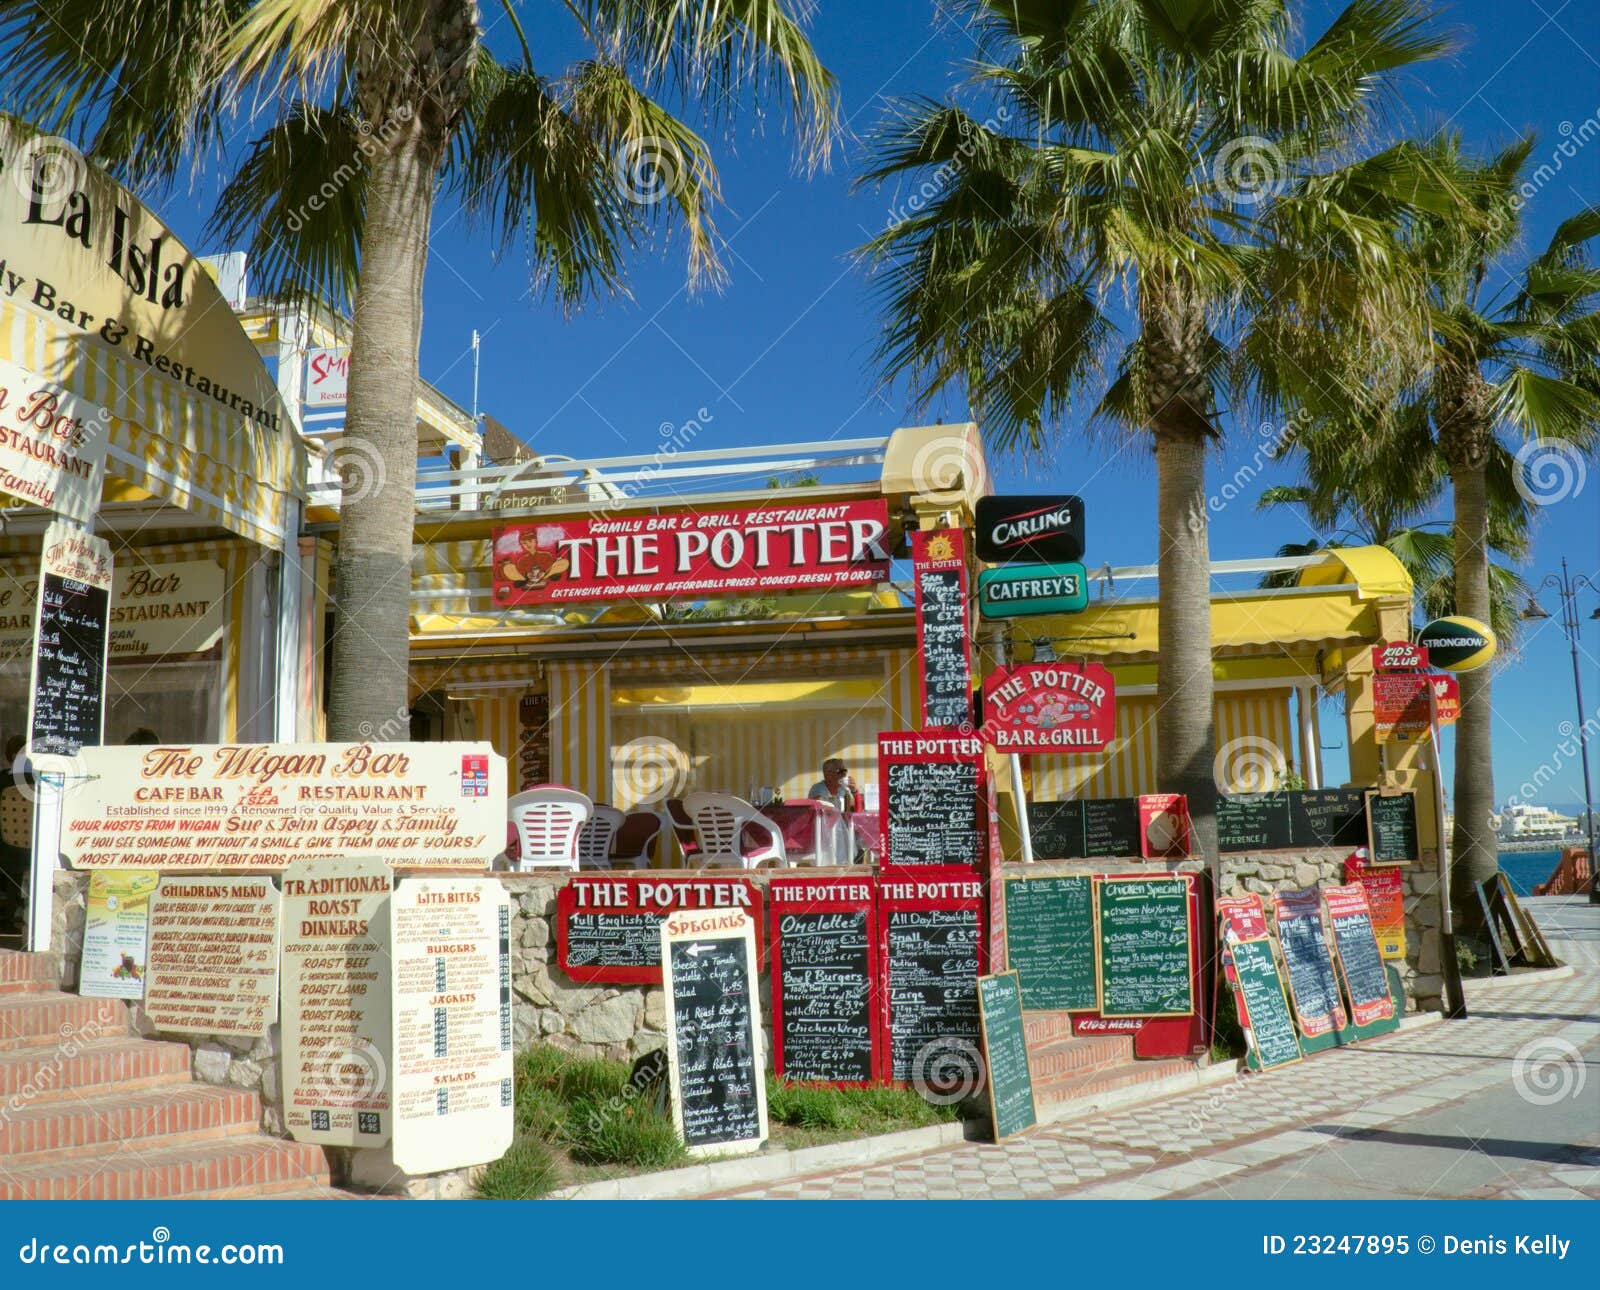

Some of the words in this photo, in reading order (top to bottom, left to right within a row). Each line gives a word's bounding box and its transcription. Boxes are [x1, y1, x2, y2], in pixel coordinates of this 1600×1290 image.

[22, 152, 92, 249] La
[106, 205, 184, 310] Isla
[31, 278, 94, 330] Bar
[100, 318, 128, 345] &
[133, 334, 281, 433] Restaurant
[17, 390, 86, 449] Bar
[0, 425, 93, 478] STAURANT
[590, 518, 643, 535] FAMILY
[646, 517, 676, 531] BAR
[680, 517, 692, 529] &
[697, 513, 741, 529] GRILL
[744, 505, 850, 524] RESTAURANT
[991, 509, 1072, 545] CARLING
[557, 532, 660, 579] THE
[675, 519, 889, 574] POTTER
[915, 562, 931, 570] THE
[932, 559, 962, 568] POTTER
[120, 570, 182, 600] Bar
[551, 588, 601, 598] EXTENSIVE
[603, 586, 625, 595] FOOD
[626, 583, 650, 593] MENU
[652, 582, 664, 591] AT
[665, 579, 724, 590] AFFORDABLE
[725, 577, 756, 587] PRICES
[759, 574, 797, 585] COOKED
[797, 572, 832, 583] FRESH
[835, 571, 848, 581] TO
[849, 569, 885, 581] ORDER
[989, 575, 1076, 601] CAFFREY'S
[110, 601, 209, 624] ESTAURANT
[1422, 637, 1482, 648] STRONGBOW
[1384, 656, 1418, 666] CLUB
[987, 676, 1027, 711] THE
[1030, 669, 1106, 707] POTTER
[996, 729, 1038, 746] BAR
[1050, 728, 1104, 746] GRILL
[880, 740, 913, 756] THE
[916, 738, 983, 755] POTTER
[141, 746, 204, 780] The
[213, 745, 326, 785] Wigan
[331, 742, 411, 780] Bar
[134, 786, 185, 803] CAFE
[187, 785, 225, 803] BAR
[299, 784, 428, 802] RESTAURANT
[106, 804, 170, 816] Established
[173, 805, 201, 816] since
[204, 805, 229, 817] 1999
[242, 805, 298, 816] Renowned
[318, 804, 358, 816] Quality
[361, 804, 394, 815] Value
[410, 804, 456, 815] Service
[69, 819, 101, 832] YOUR
[103, 819, 143, 831] HOSTS
[145, 819, 176, 831] FROM
[178, 819, 221, 832] WIGAN
[226, 816, 264, 834] Sue
[278, 816, 318, 832] John
[323, 816, 379, 836] Aspey
[395, 815, 459, 836] Family
[76, 836, 90, 849] IF
[92, 837, 115, 848] YOU
[116, 837, 135, 848] SEE
[137, 837, 193, 849] SOMEONE
[196, 837, 247, 848] WITHOUT
[250, 837, 258, 848] A
[261, 836, 305, 848] SMILE
[307, 836, 334, 848] GIVE
[338, 836, 372, 848] THEM
[377, 836, 400, 848] ONE
[403, 836, 420, 848] OF
[79, 853, 119, 865] MOST
[120, 853, 168, 865] MAJOR
[250, 852, 286, 865] CARDS
[231, 885, 267, 898] MENU
[284, 875, 391, 896] TRADITIONAL
[772, 886, 804, 901] THE
[806, 884, 871, 901] POTTER
[880, 883, 914, 900] THE
[917, 882, 984, 899] POTTER
[416, 893, 446, 904] LITE
[447, 892, 481, 903] BITES
[573, 882, 629, 907] THE
[637, 882, 752, 908] POTTER
[308, 899, 362, 916] ROAST
[301, 919, 369, 937] DINNERS
[667, 913, 747, 936] SPECIALS
[426, 943, 477, 954] BURGERS
[302, 958, 344, 969] ROAST
[344, 957, 371, 969] BEEF
[814, 969, 863, 985] Burgers
[299, 984, 336, 995] ROAST
[337, 983, 368, 995] LAMB
[674, 986, 696, 998] Salad
[891, 988, 925, 1001] Large
[429, 994, 476, 1006] JACKETS
[301, 1009, 333, 1021] ROAST
[334, 1009, 365, 1021] PORK
[1078, 1019, 1107, 1029] KIDS
[1108, 1019, 1143, 1029] MEALS
[299, 1036, 333, 1047] ROAST
[433, 1071, 476, 1084] SALADS
